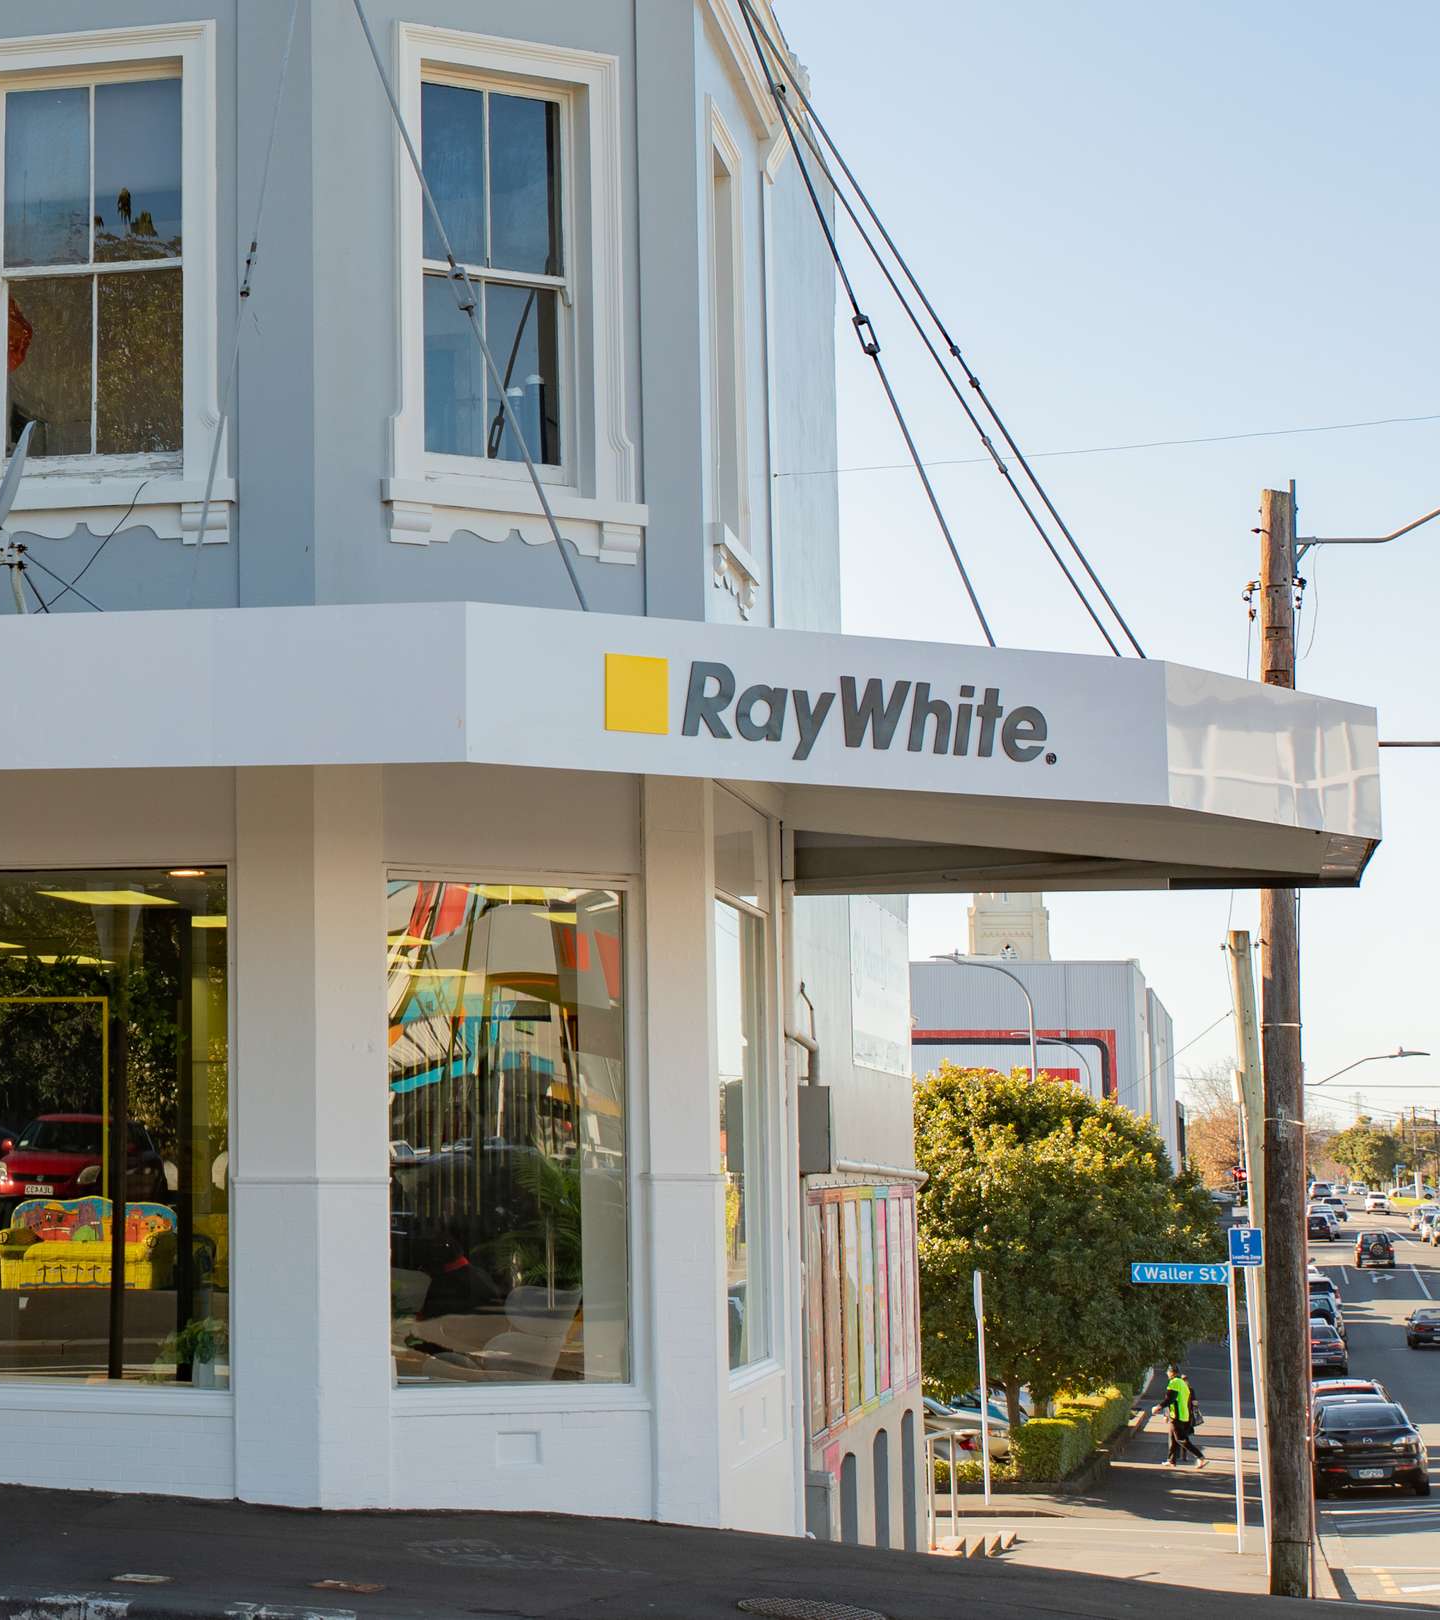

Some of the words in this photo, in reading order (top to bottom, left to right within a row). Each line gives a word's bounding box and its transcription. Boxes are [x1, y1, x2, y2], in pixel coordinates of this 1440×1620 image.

[1240, 1230, 1251, 1243] P
[1243, 1243, 1250, 1254] 5
[1144, 1266, 1194, 1281] Waller
[1199, 1267, 1217, 1281] St
